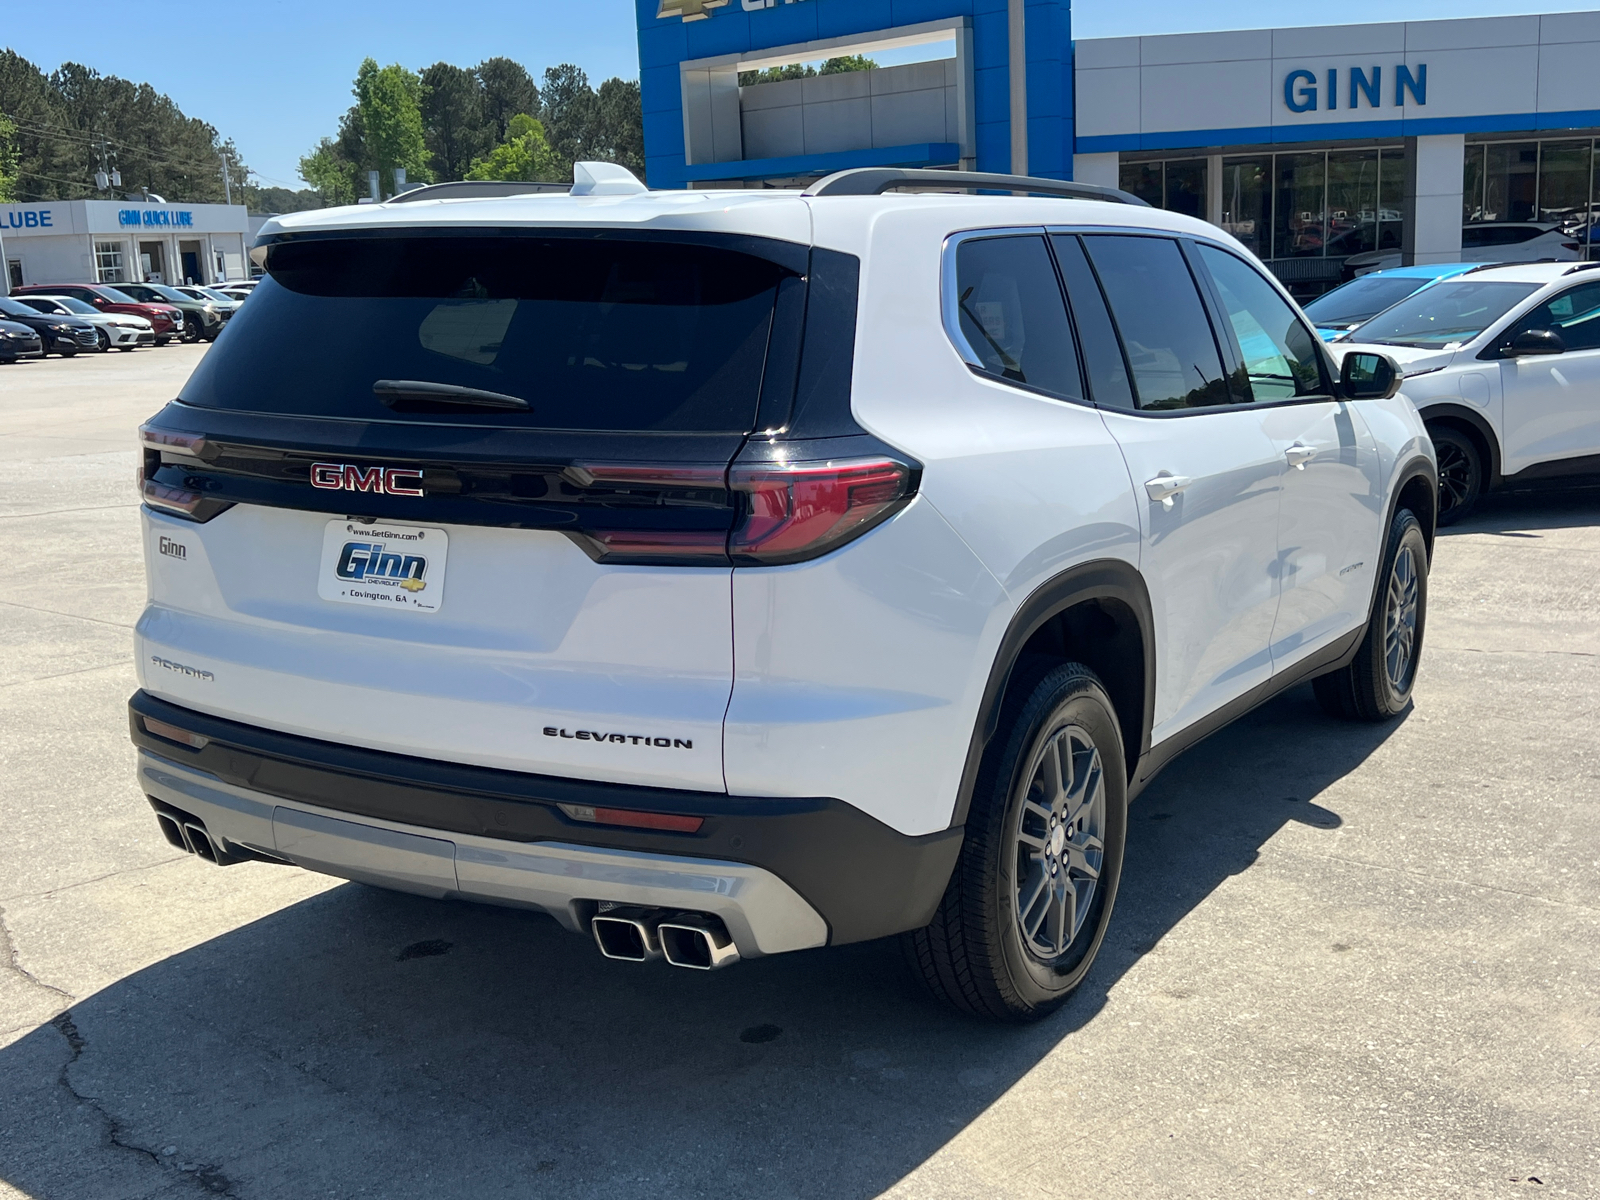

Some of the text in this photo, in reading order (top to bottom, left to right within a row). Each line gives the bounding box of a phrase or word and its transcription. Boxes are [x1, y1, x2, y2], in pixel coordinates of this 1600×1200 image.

[1284, 64, 1427, 113] GINN
[119, 209, 193, 226] GINN QUICK LUBE
[310, 462, 424, 497] GMC
[159, 535, 186, 557] Ginn
[353, 529, 418, 541] www.GetGinn.com
[336, 541, 427, 580] Ginn
[367, 579, 399, 587] CHEVROLET
[350, 590, 407, 603] Covington, GA
[543, 726, 693, 749] ELEVATION
